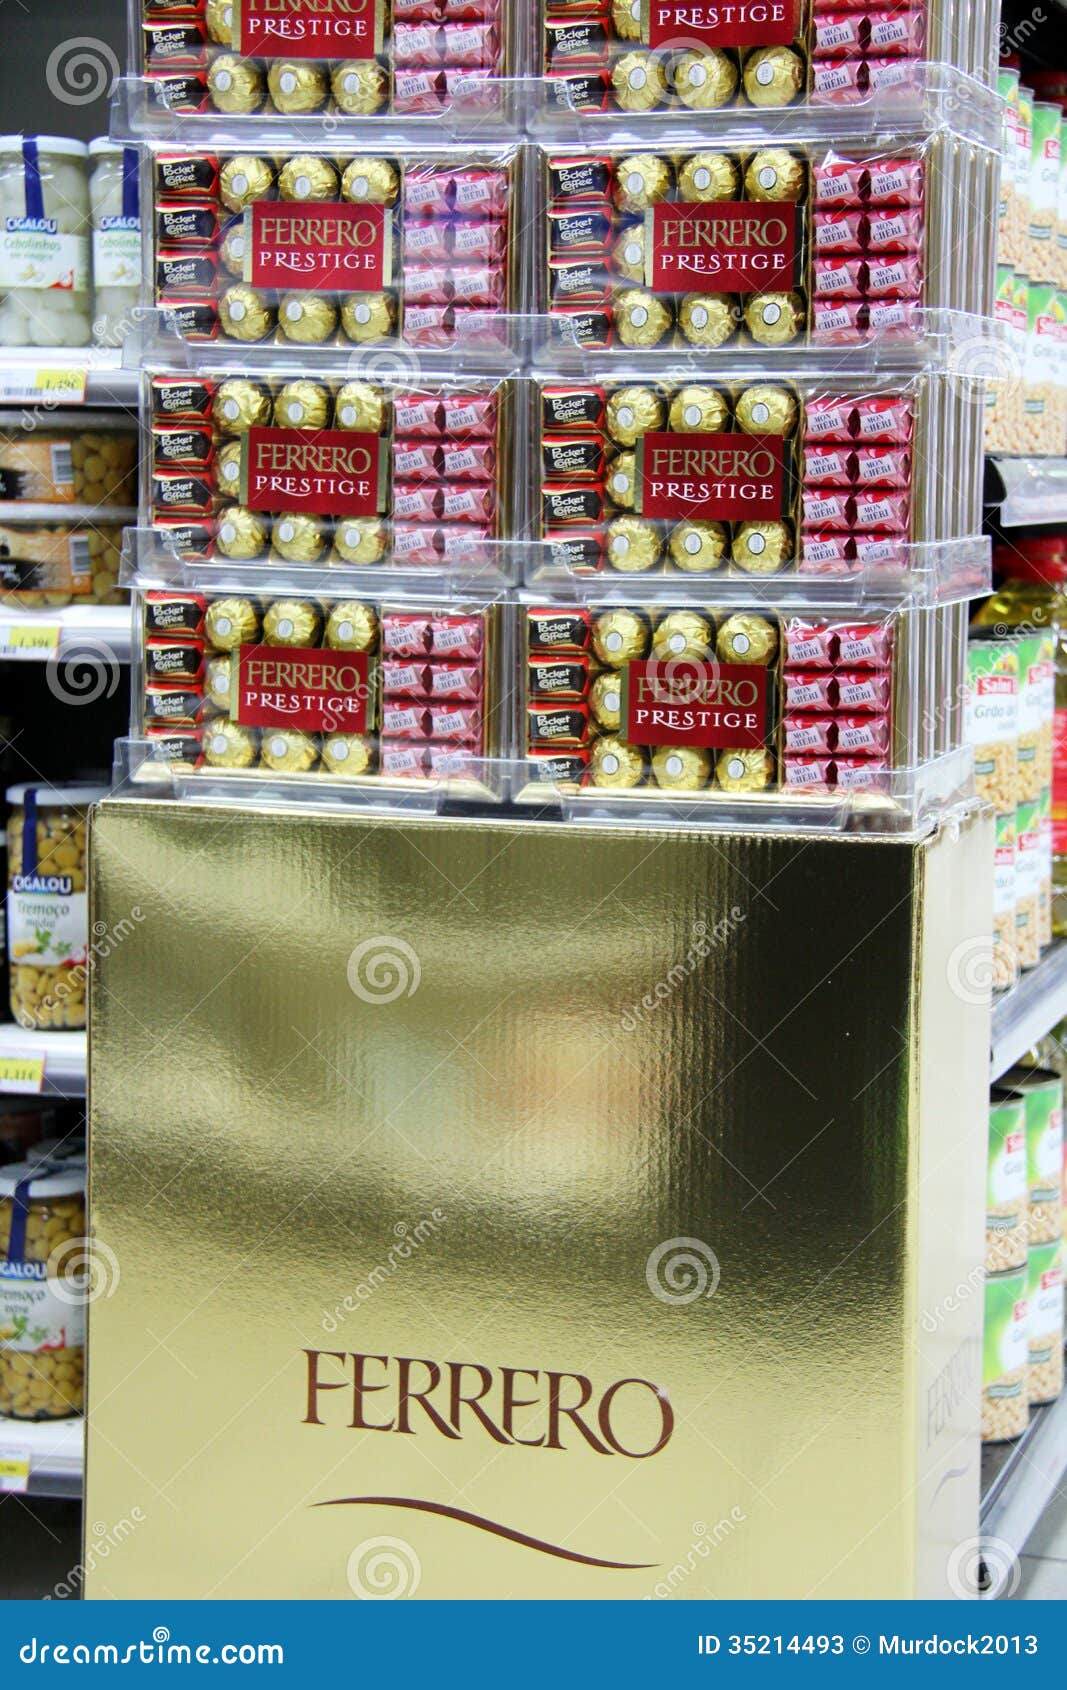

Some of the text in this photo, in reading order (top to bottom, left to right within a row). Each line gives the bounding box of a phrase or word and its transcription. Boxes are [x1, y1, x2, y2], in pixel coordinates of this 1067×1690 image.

[658, 4, 787, 31] PRESTIGE
[152, 29, 186, 43] Pocket
[248, 19, 368, 40] PRESTIGE
[555, 29, 590, 42] Pocket
[163, 164, 195, 177] Pocket
[558, 168, 594, 181] Pocket
[163, 213, 196, 226] Pocket
[558, 218, 594, 231] Pocket
[259, 217, 378, 247] FERRERO
[661, 218, 788, 248] FERRERO
[163, 262, 196, 275] Pocket
[259, 251, 377, 273] PRESTIGE
[660, 252, 787, 274] PRESTIGE
[558, 268, 593, 281] Pocket
[160, 387, 194, 400] Pocket
[550, 398, 586, 411] Pocket
[161, 434, 194, 447] Pocket
[254, 443, 372, 475] FERRERO
[550, 446, 586, 459] Pocket
[650, 448, 776, 479] FERRERO
[161, 480, 194, 493] Pocket
[255, 475, 371, 497] PRESTIGE
[650, 482, 774, 504] PRESTIGE
[550, 494, 586, 507] Pocket
[152, 604, 185, 617] Pocket
[537, 621, 571, 634] Pocket
[152, 649, 185, 662] Pocket
[244, 660, 360, 692] FERRERO
[537, 668, 571, 681] Pocket
[636, 676, 760, 707] FERRERO
[152, 695, 185, 708] Pocket
[244, 691, 360, 713] PRESTIGE
[537, 714, 571, 728] Pocket
[635, 708, 759, 730] PRESTIGE
[0, 1261, 47, 1281] GALOU
[301, 1348, 675, 1459] FERRERO
